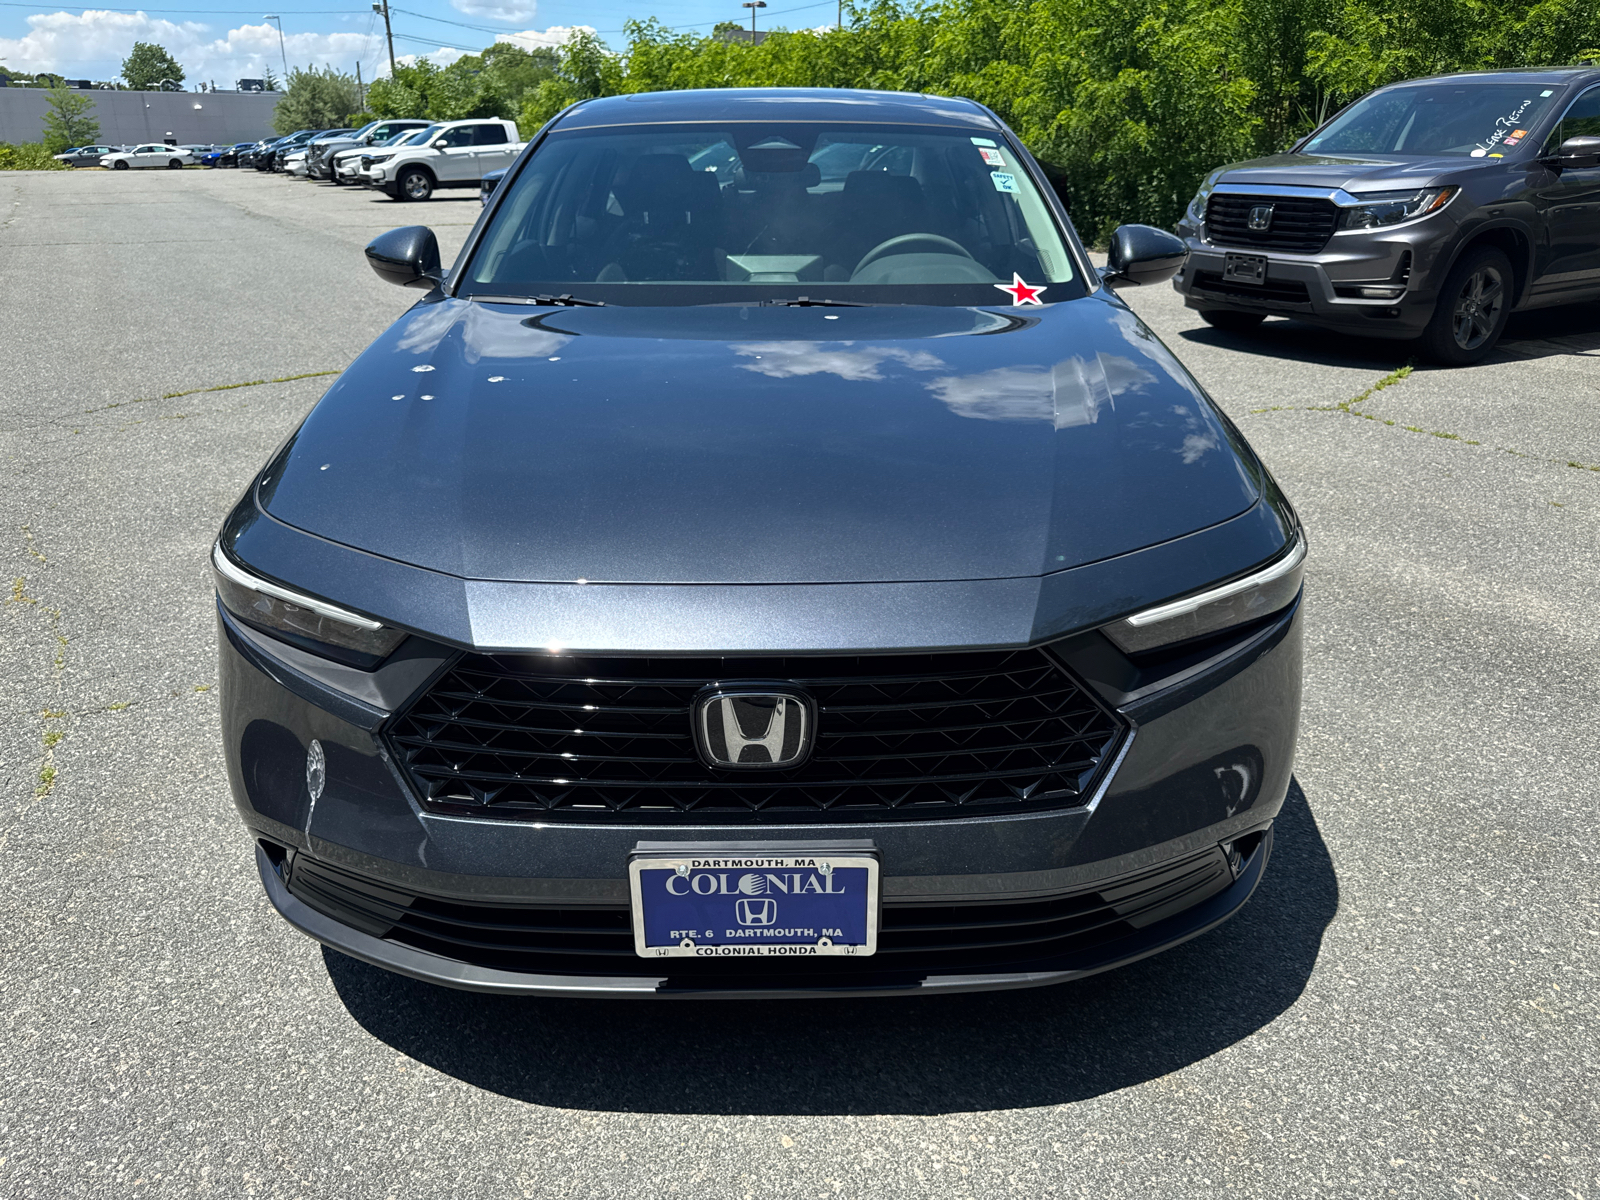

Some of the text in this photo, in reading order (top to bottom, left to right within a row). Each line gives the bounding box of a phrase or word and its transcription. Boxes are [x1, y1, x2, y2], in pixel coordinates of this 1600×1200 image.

[691, 859, 816, 868] DARTMOUTH, MA
[665, 873, 846, 896] COLONIAL
[670, 928, 844, 939] RTE. 6 DARTMOUTH, MA
[695, 946, 817, 956] COLONIAL HONDA
